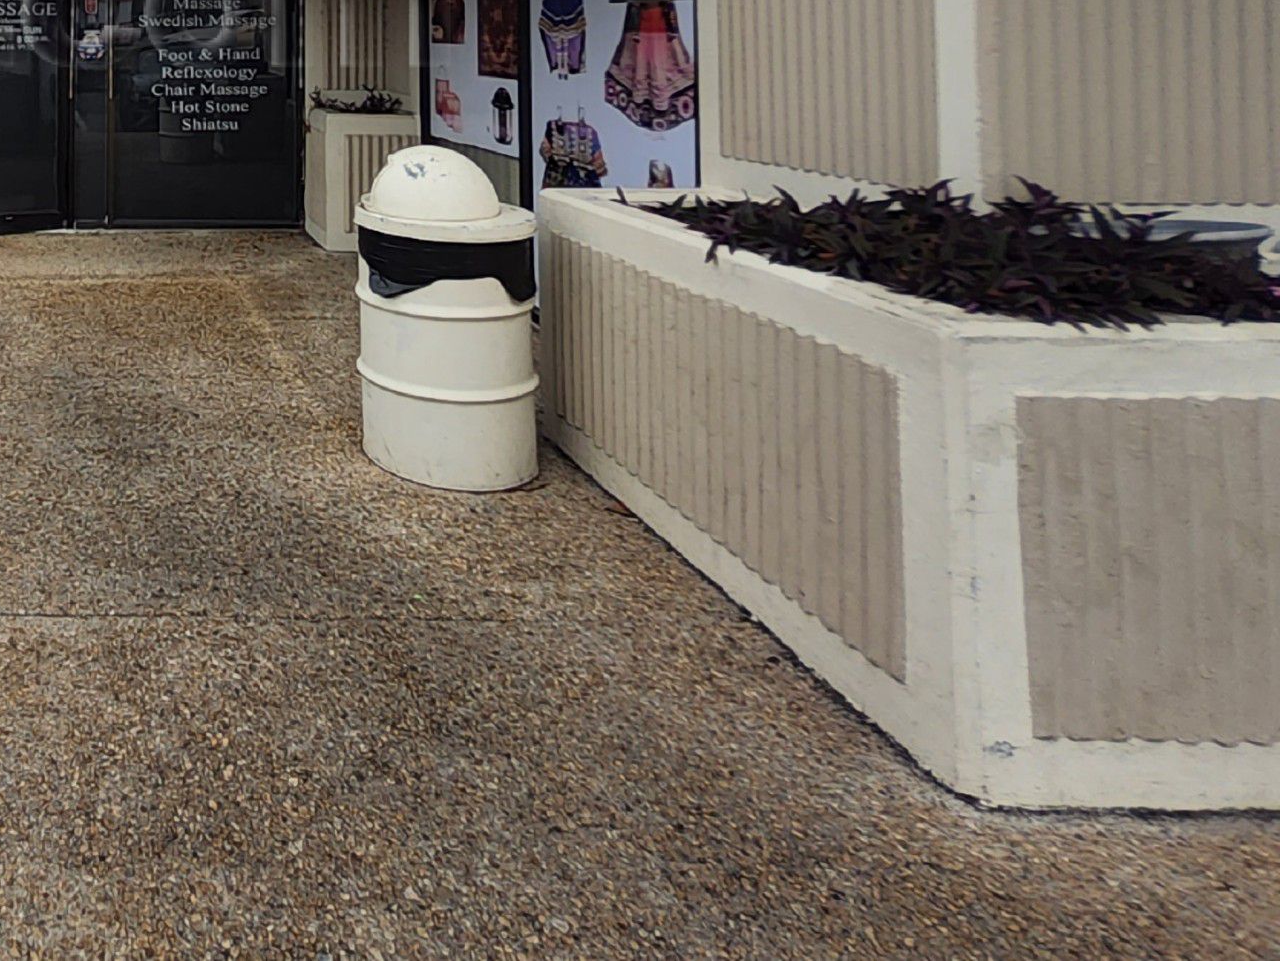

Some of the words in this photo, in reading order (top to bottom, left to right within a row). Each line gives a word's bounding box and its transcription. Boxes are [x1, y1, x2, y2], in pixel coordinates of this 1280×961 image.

[138, 14, 203, 27] Swedish
[208, 14, 277, 27] Massage
[158, 48, 193, 62] Foot
[198, 48, 214, 61] &
[220, 47, 261, 60] Hand
[161, 65, 257, 81] Reflexology
[151, 83, 195, 96] Chair
[200, 83, 268, 97] Massage
[171, 101, 200, 113] Hot
[205, 100, 250, 113] Stone
[181, 117, 239, 131] Shiatsu
